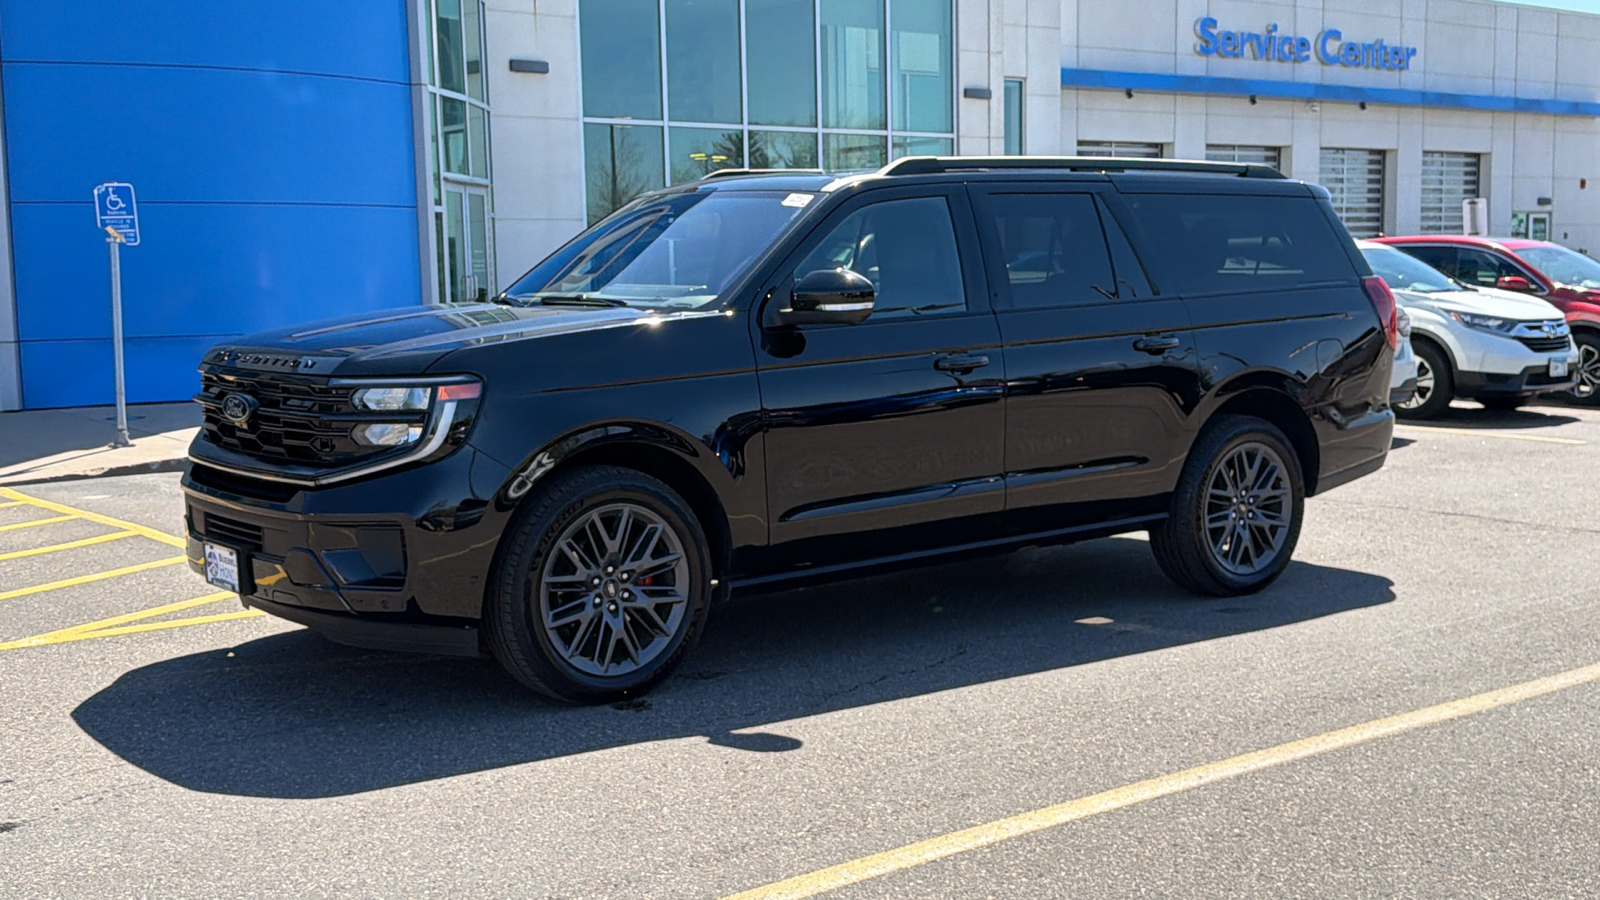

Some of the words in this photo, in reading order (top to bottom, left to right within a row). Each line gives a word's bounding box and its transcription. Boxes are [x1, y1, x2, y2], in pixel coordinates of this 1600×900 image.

[1195, 17, 1311, 62] Service
[1316, 29, 1417, 70] Center
[226, 397, 244, 417] Ford
